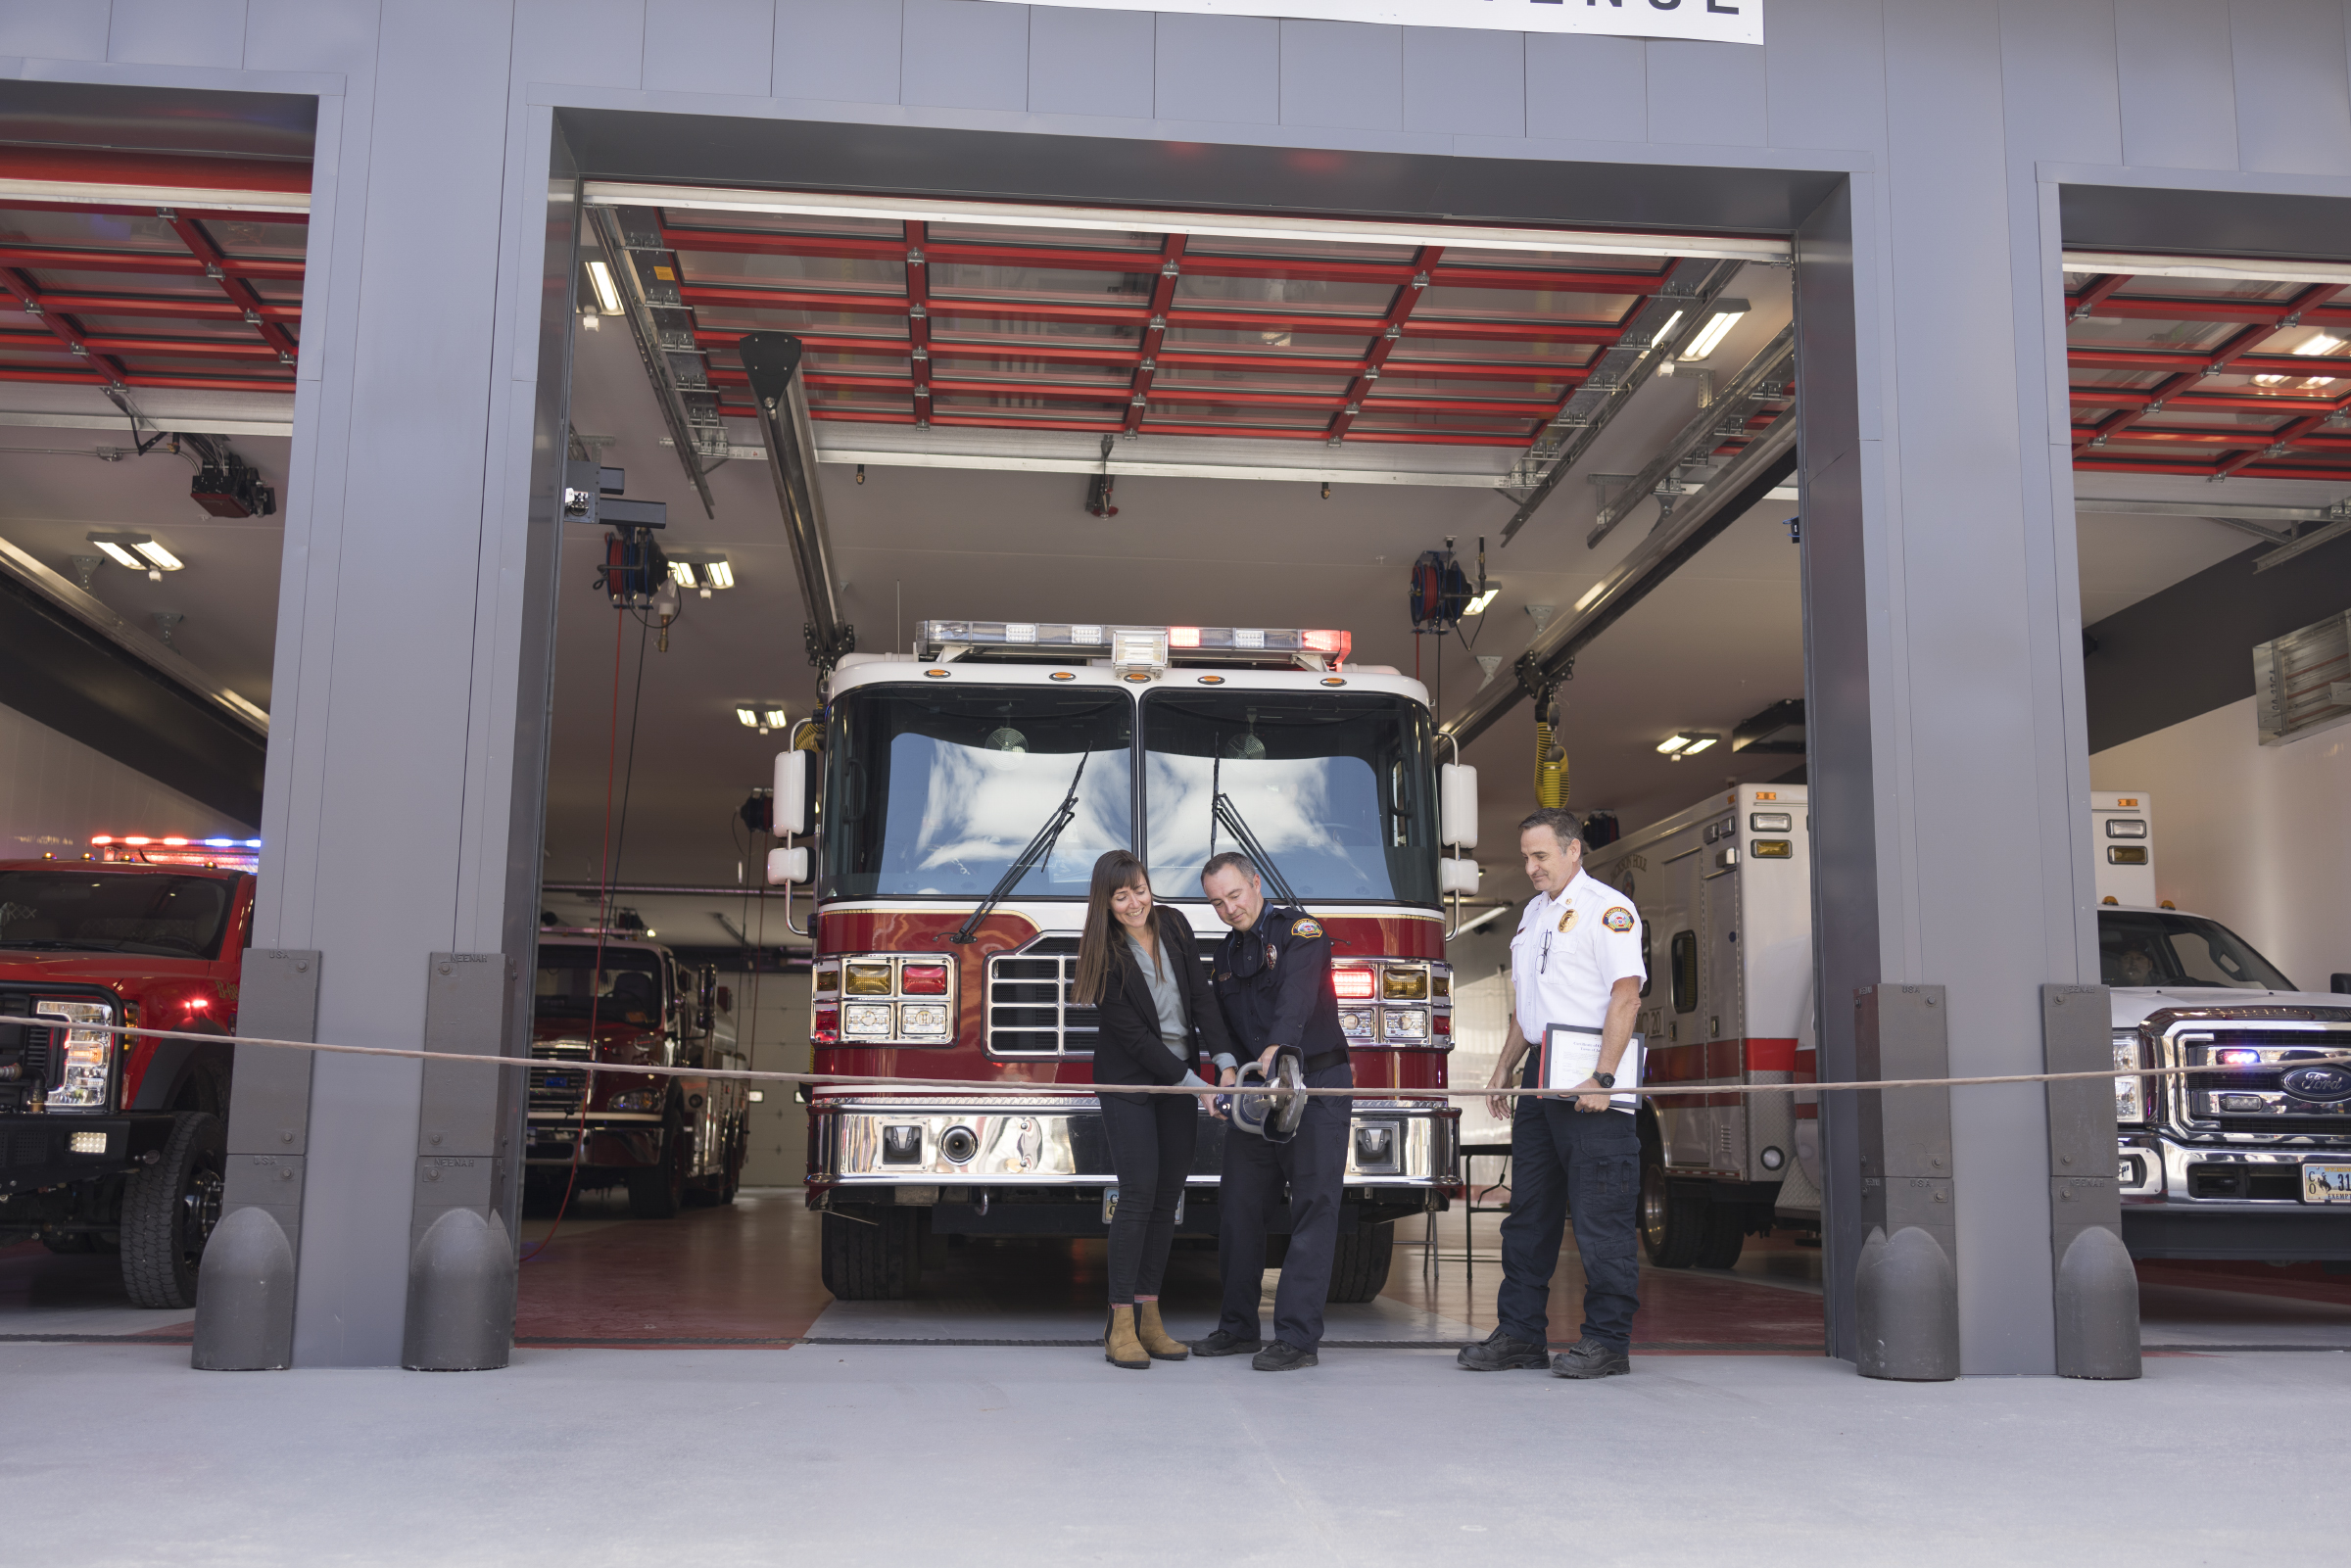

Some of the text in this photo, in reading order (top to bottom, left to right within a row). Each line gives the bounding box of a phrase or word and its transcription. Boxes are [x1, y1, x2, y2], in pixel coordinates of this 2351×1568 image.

[268, 949, 290, 959] USA
[451, 953, 488, 963] NEENAH
[1901, 985, 1921, 994] USA
[2061, 985, 2095, 994] NEENAH
[1651, 1010, 1661, 1035] 20
[2301, 1071, 2343, 1090] Ford
[254, 1156, 277, 1165] USA
[434, 1158, 475, 1167] NEENAH
[1910, 1178, 1931, 1188] USA
[2069, 1177, 2105, 1188] NEENAH
